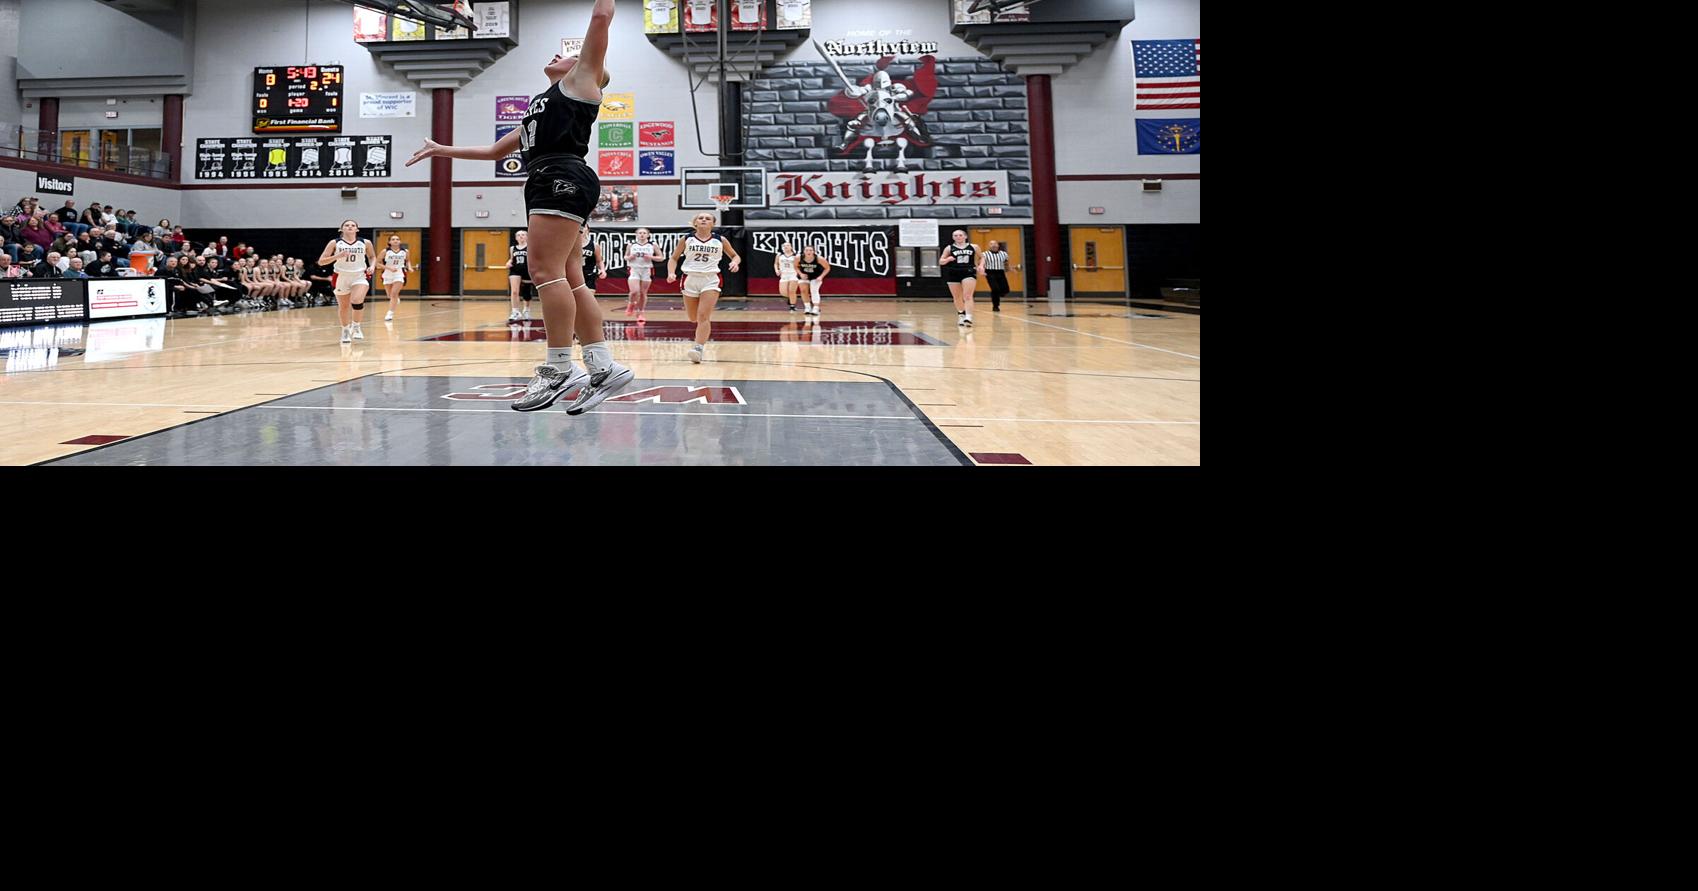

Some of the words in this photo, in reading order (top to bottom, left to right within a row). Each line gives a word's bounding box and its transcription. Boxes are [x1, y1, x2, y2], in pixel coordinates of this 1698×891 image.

[878, 29, 892, 37] OF
[824, 39, 939, 56] Northview
[265, 73, 276, 86] 8
[309, 80, 318, 91] 2
[321, 73, 341, 85] 24
[259, 98, 268, 108] 0
[524, 98, 549, 118] LVES
[608, 127, 624, 142] C
[38, 177, 72, 192] Visitors
[775, 173, 997, 205] Knights
[689, 245, 719, 253] PATRIOTS
[753, 231, 889, 275] KNIGHTS
[694, 253, 709, 262] 25
[439, 384, 747, 405] WC
